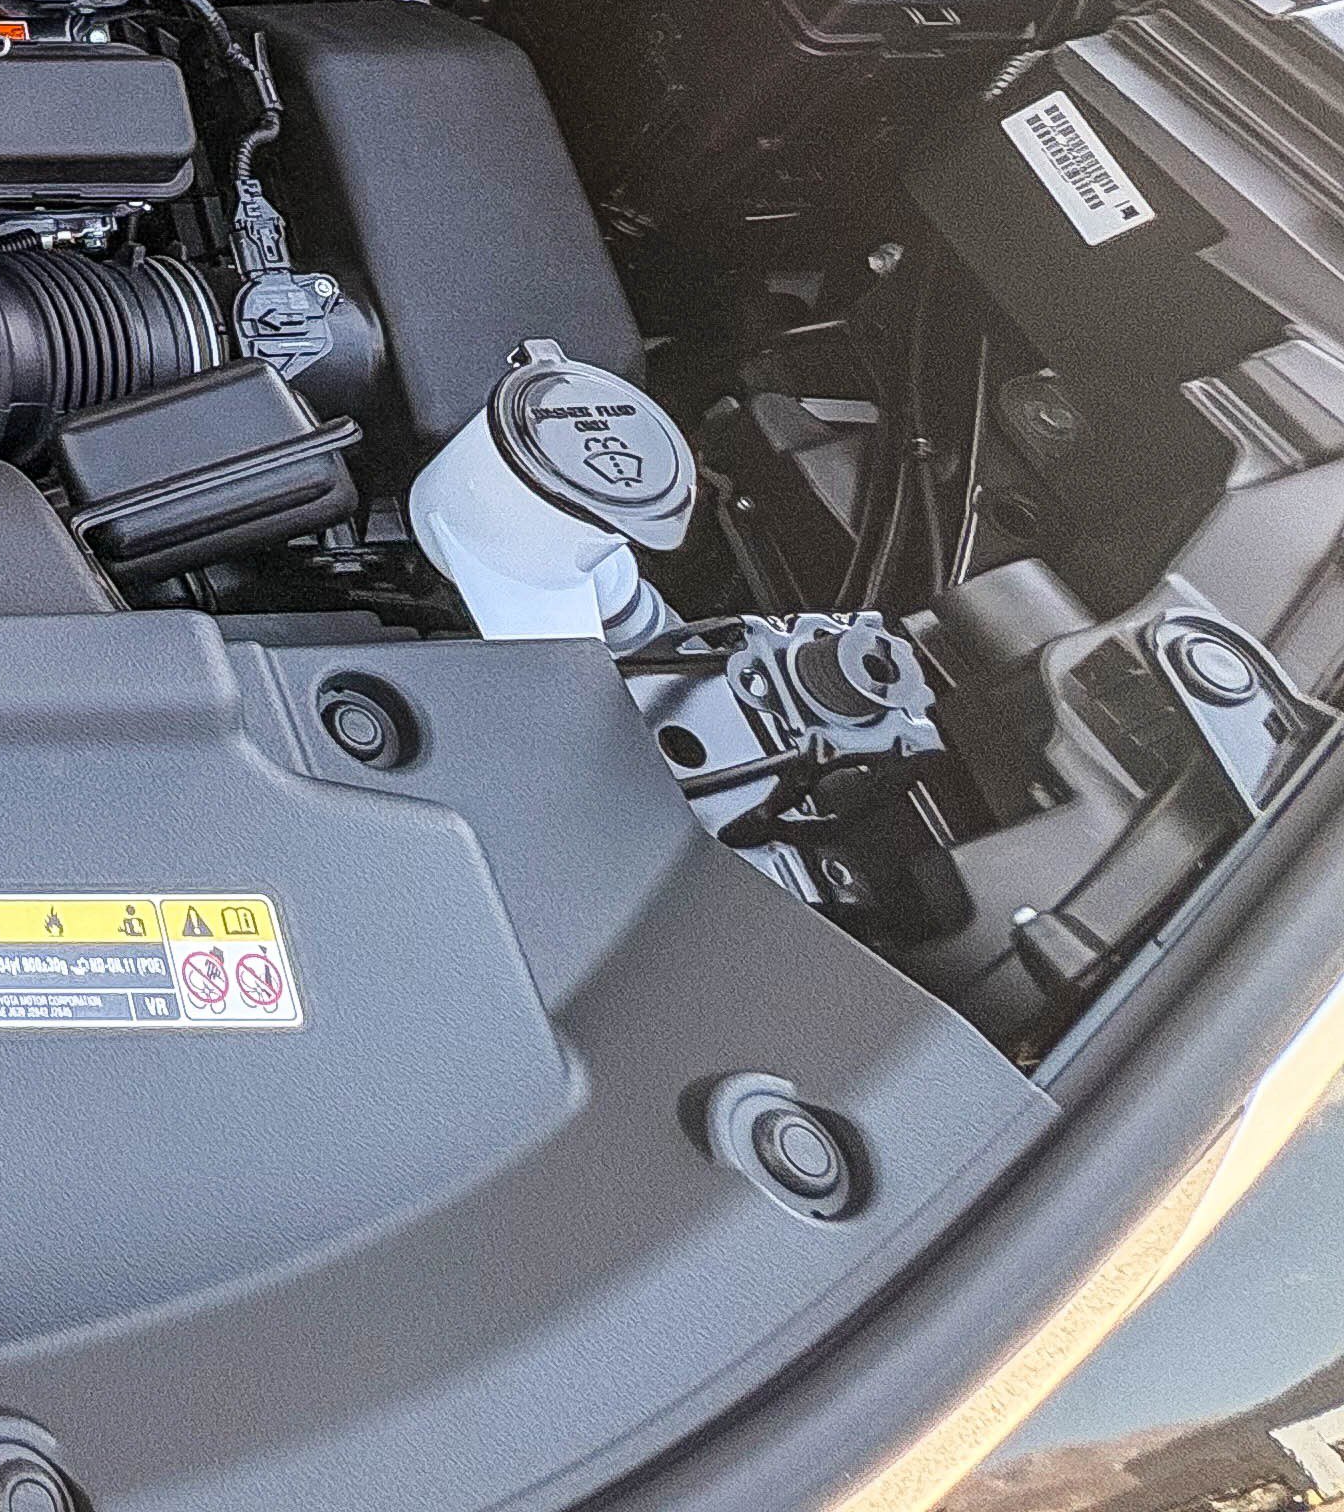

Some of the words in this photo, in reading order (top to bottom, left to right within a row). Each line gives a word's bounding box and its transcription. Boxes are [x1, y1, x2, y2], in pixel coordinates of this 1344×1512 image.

[595, 404, 637, 417] FLUID
[574, 419, 611, 432] ONLY
[20, 994, 48, 1006] MOTOR
[144, 996, 170, 1016] VR
